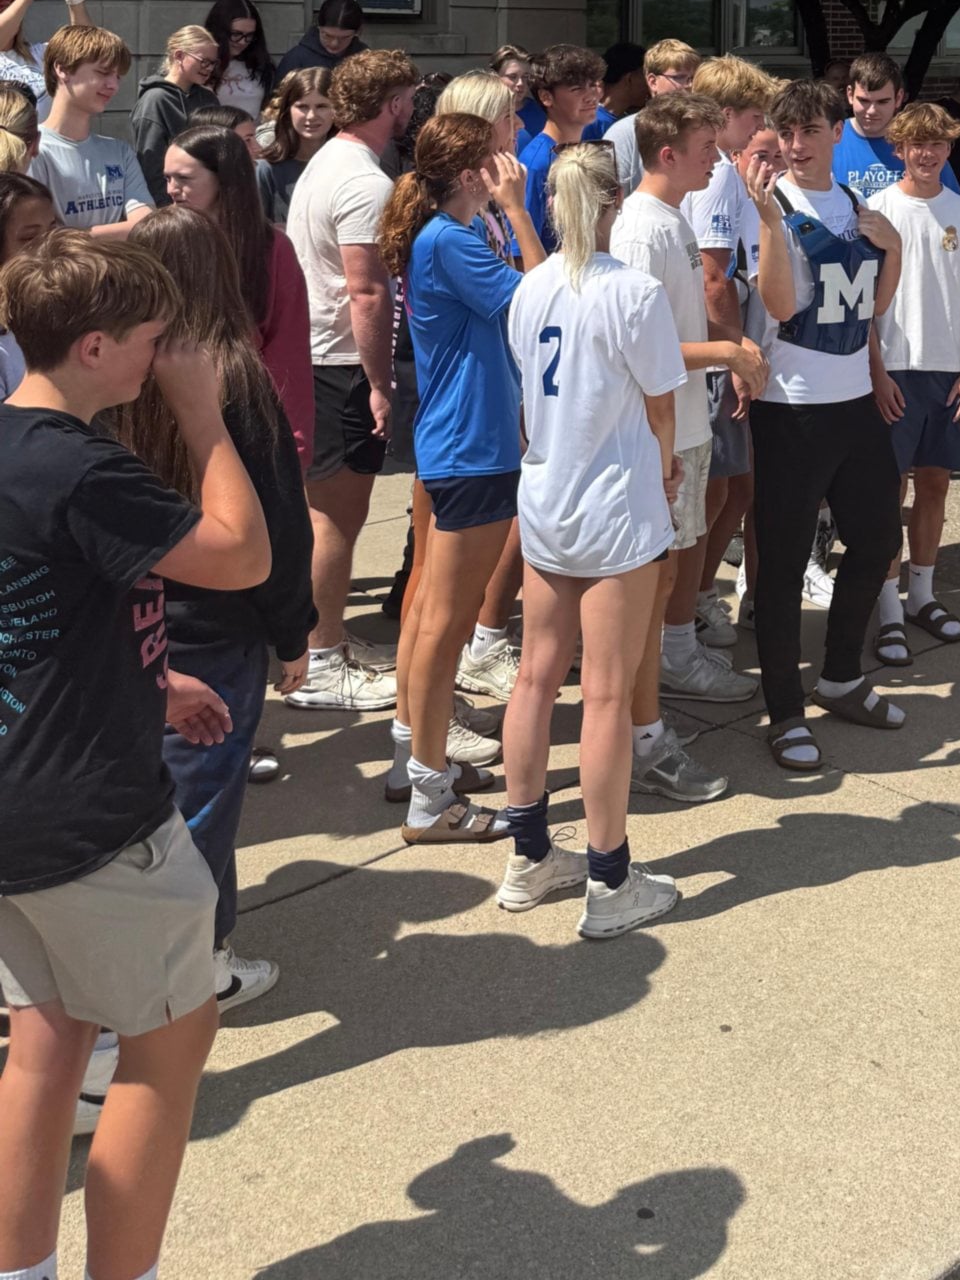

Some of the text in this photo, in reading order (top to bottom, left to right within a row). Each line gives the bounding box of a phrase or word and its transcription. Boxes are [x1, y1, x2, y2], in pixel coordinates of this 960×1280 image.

[817, 259, 878, 324] M
[539, 326, 562, 397] 2
[0, 555, 17, 573] EE
[1, 589, 56, 614] SBURGH
[0, 629, 60, 644] CHSTER
